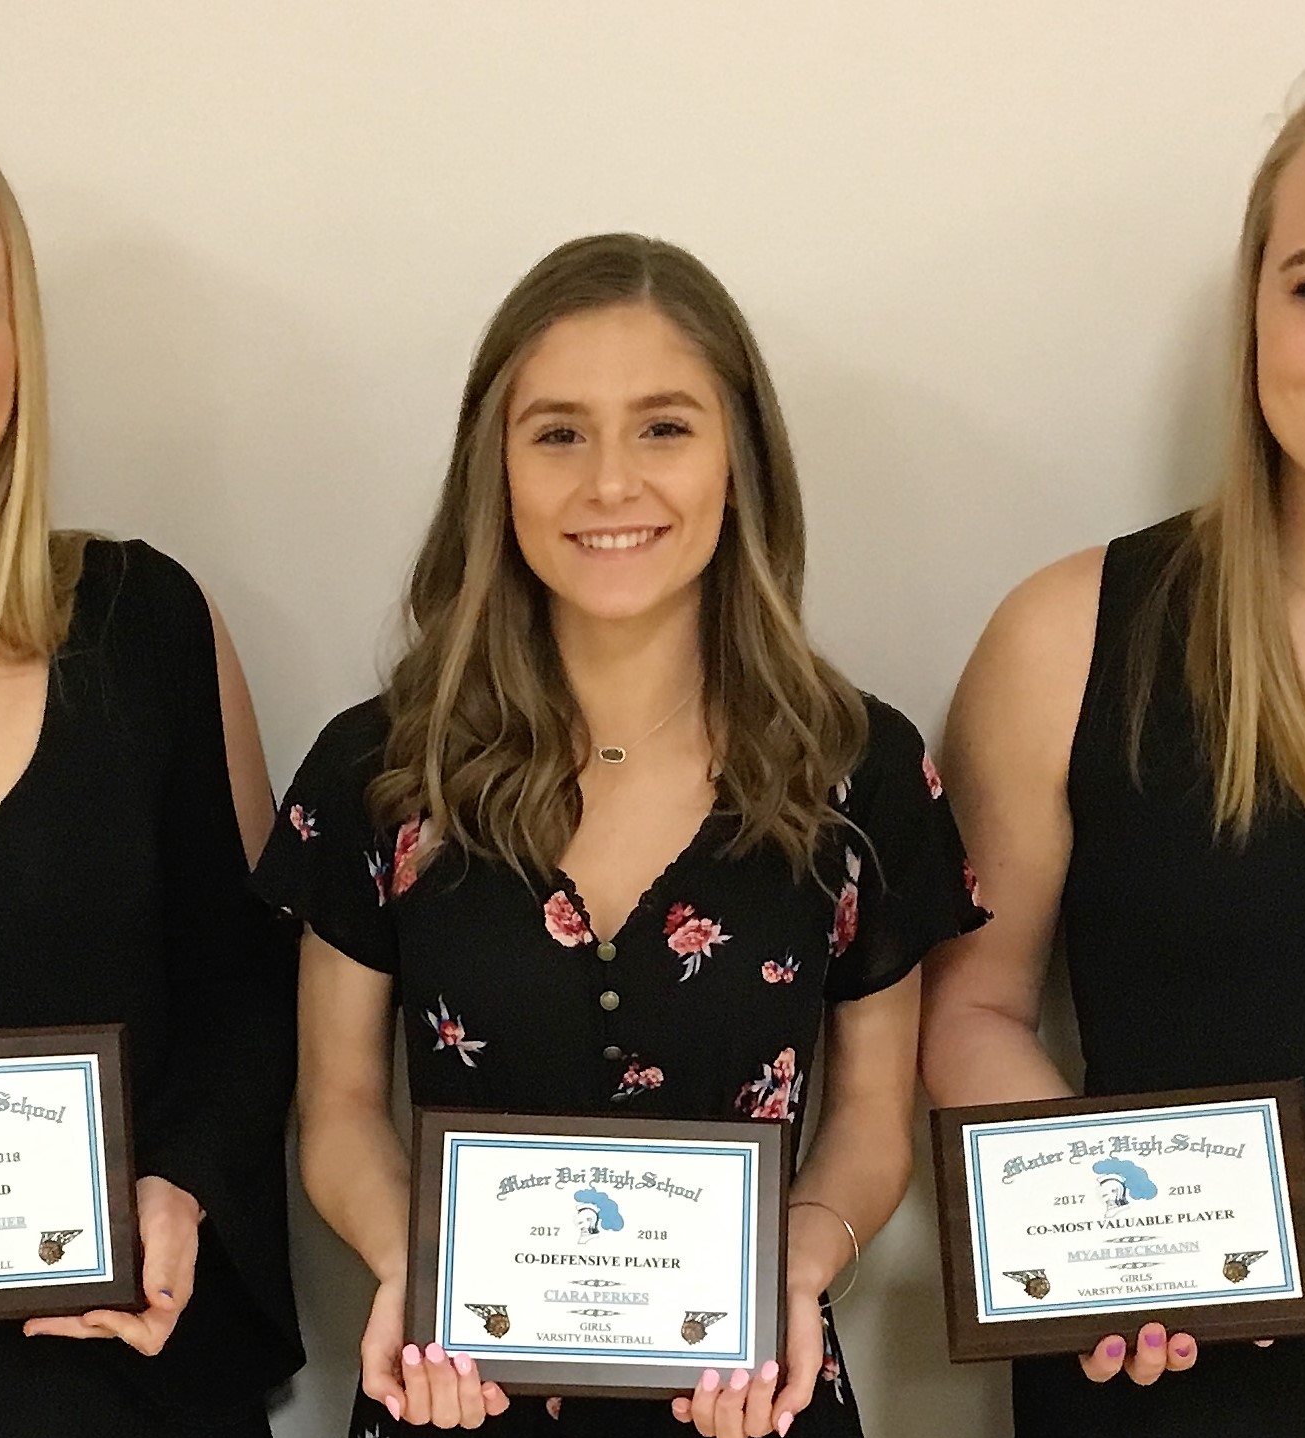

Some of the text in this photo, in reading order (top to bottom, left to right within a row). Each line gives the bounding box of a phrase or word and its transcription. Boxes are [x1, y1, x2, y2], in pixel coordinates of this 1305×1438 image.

[1002, 1133, 1246, 1184] Mater Dei High School
[496, 1166, 703, 1202] Mater Dei High School
[1168, 1184, 1202, 1196] 2018
[1053, 1194, 1085, 1206] 2017
[1026, 1209, 1235, 1236] CO-MOST VALUABLE PLAYER
[529, 1226, 560, 1237] 2017
[637, 1230, 668, 1240] 2018
[1068, 1241, 1200, 1261] MYAH BECKMANN
[514, 1253, 681, 1269] CO-DEFENSIVE PLAYER
[1120, 1273, 1153, 1283] GIRLS
[1078, 1280, 1198, 1297] VARSITY BASKETBALL
[544, 1290, 649, 1304] CIARA PERKES
[580, 1322, 611, 1332] GIRLS
[536, 1333, 654, 1345] VARSITY BASKETBALL
